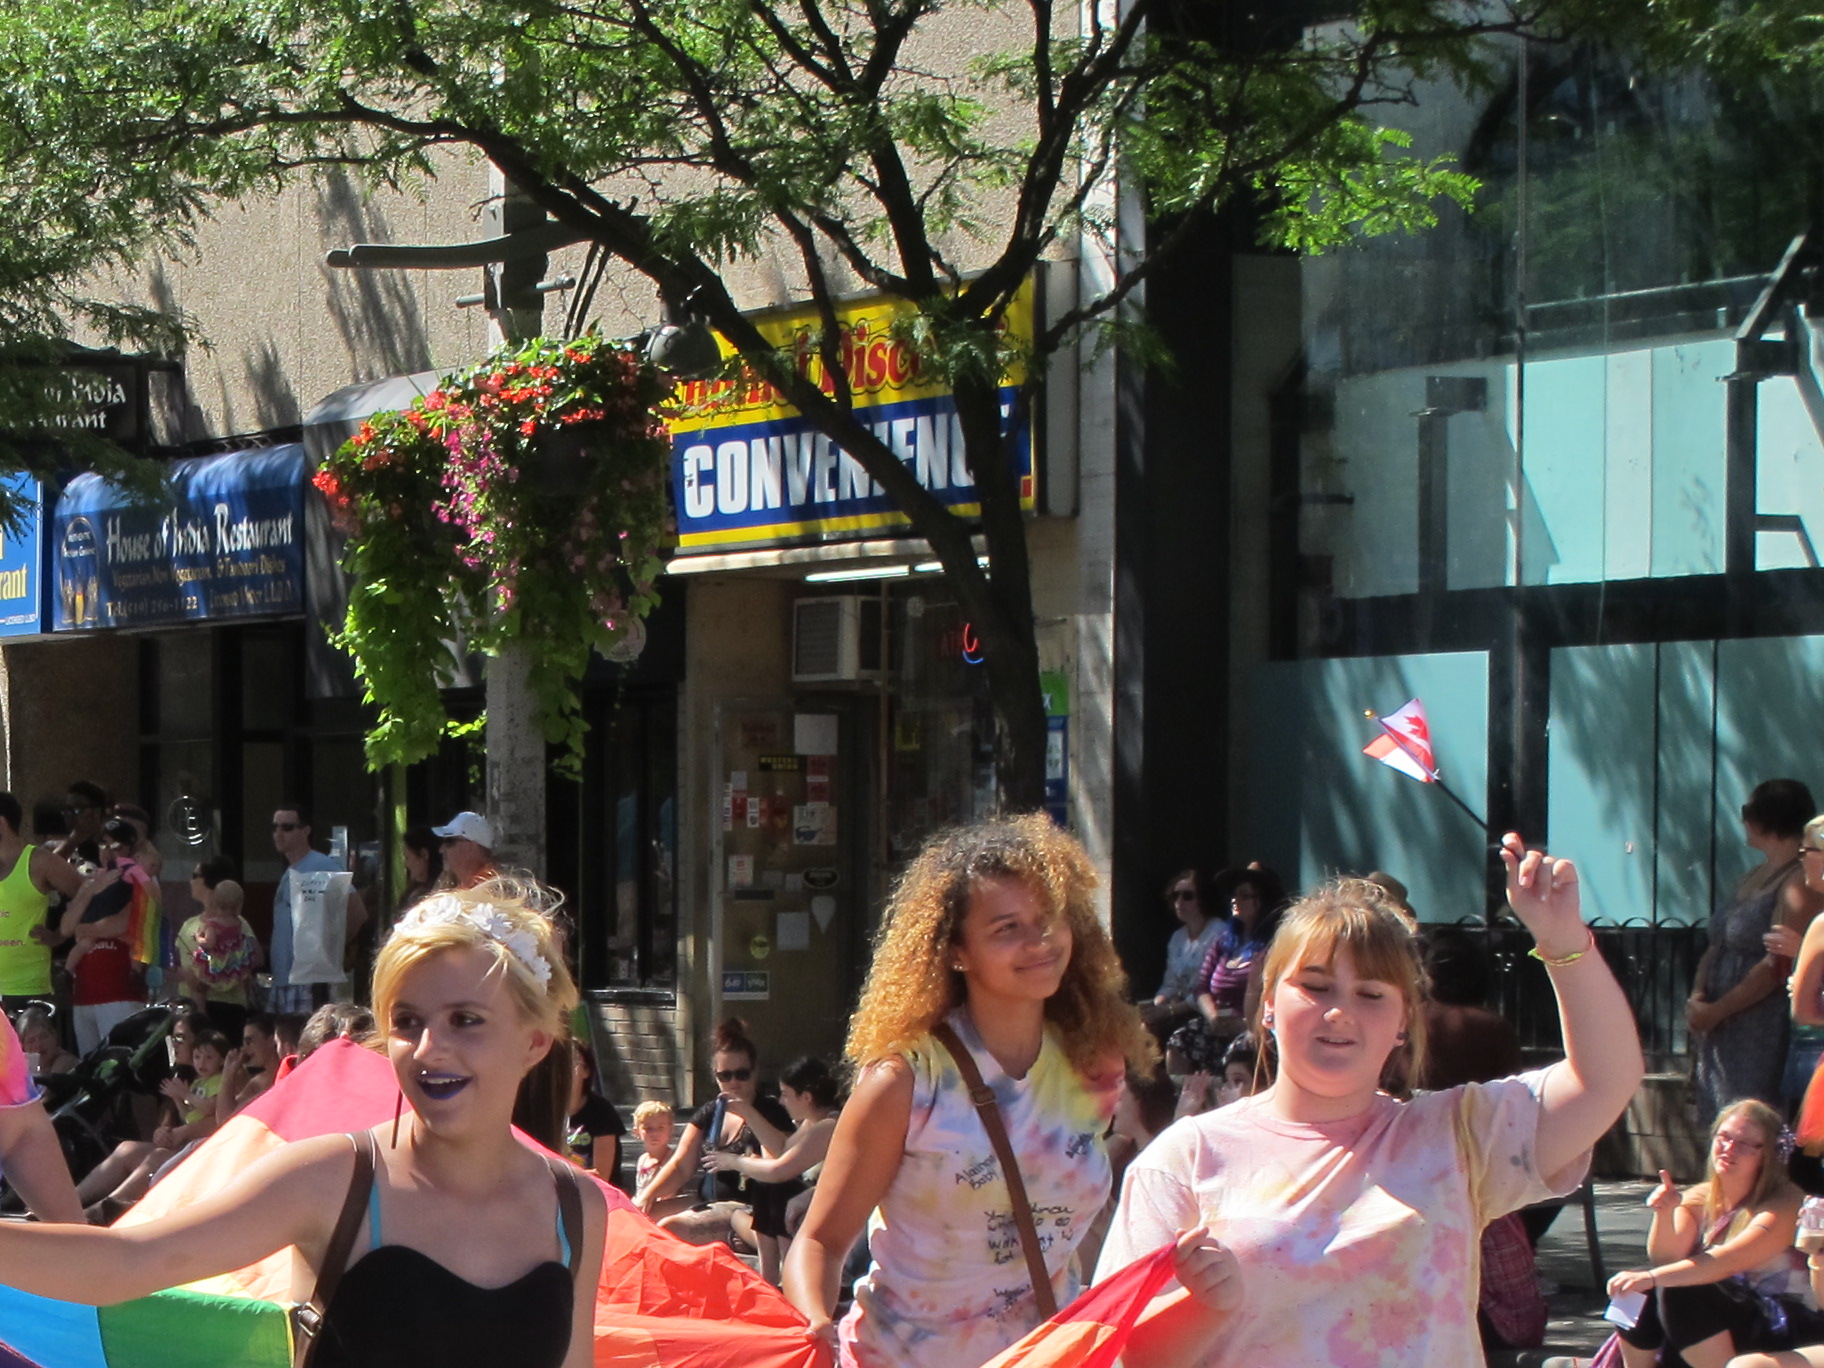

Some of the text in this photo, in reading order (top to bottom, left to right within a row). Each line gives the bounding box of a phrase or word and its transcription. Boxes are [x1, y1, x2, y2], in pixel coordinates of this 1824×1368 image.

[106, 503, 293, 565] House of India Restaurant
